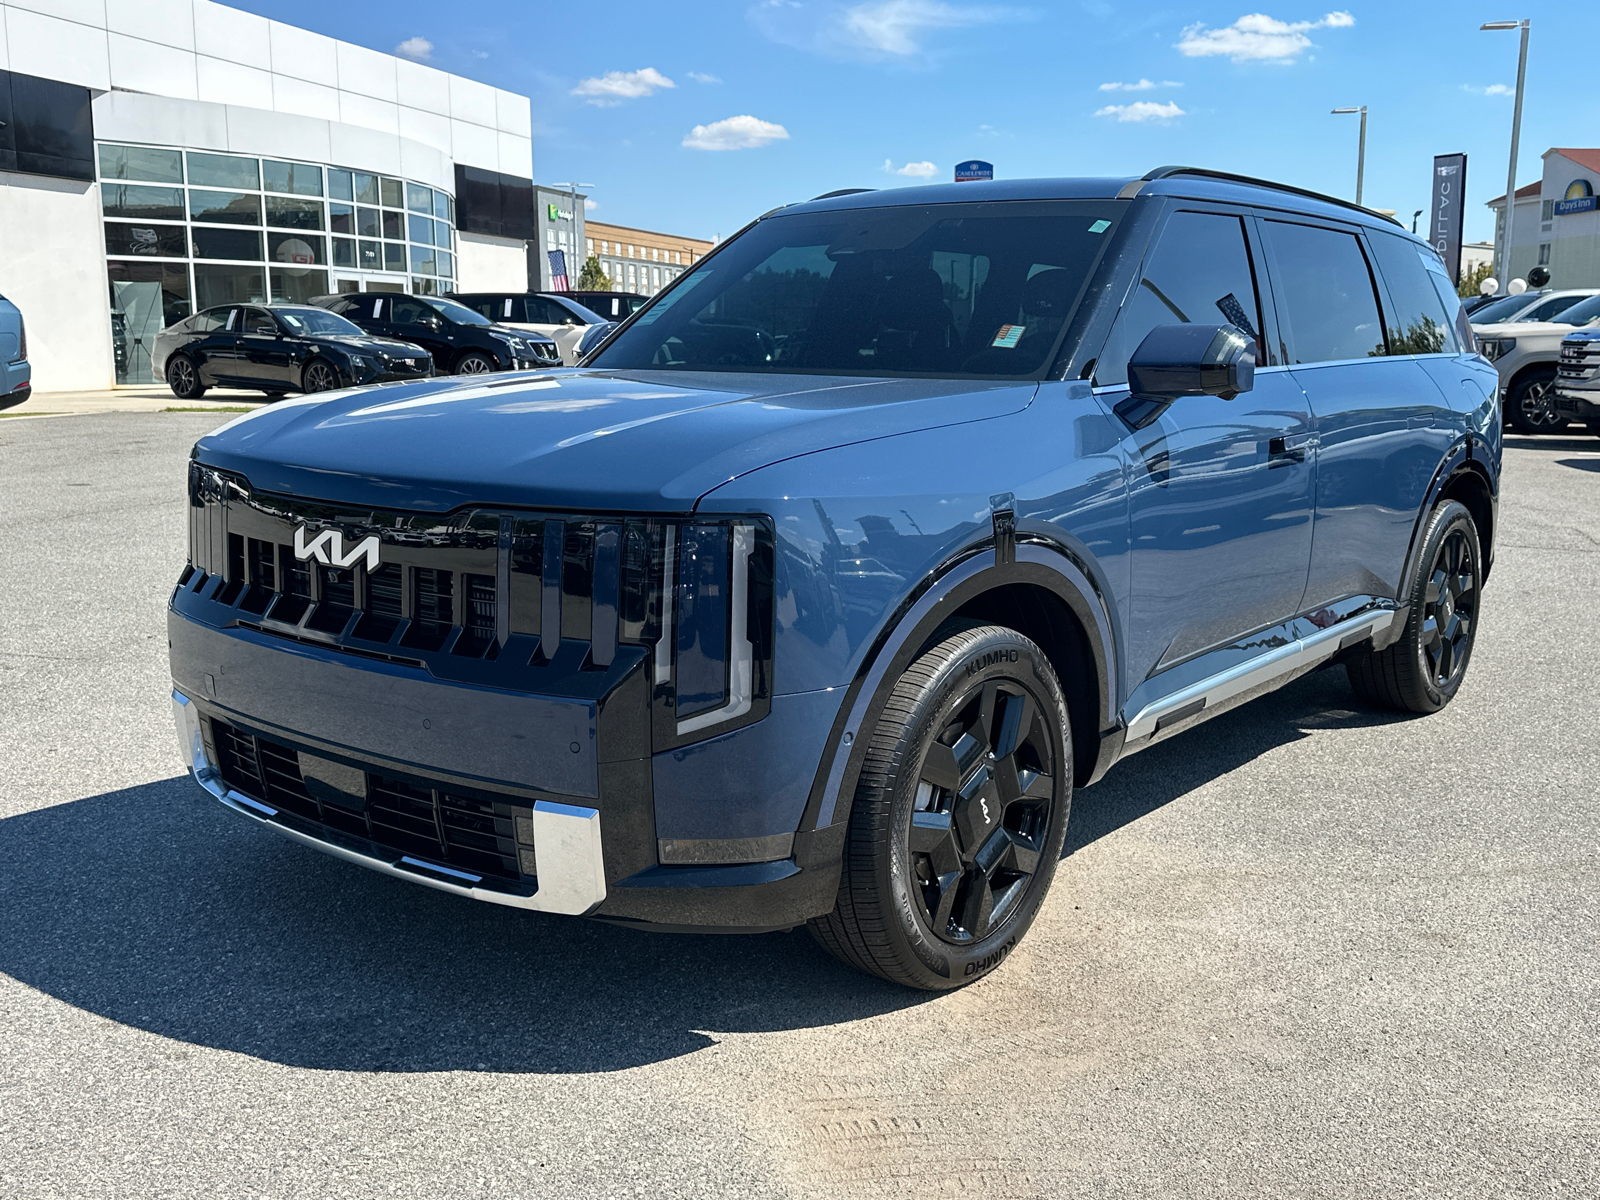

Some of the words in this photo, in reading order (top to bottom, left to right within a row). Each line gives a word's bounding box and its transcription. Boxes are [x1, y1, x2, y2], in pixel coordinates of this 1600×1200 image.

[1560, 201, 1577, 211] Days
[1578, 200, 1591, 208] Inn
[294, 525, 380, 572] KIA
[964, 649, 1019, 680] KUMHO
[964, 935, 1016, 977] KUMHO
